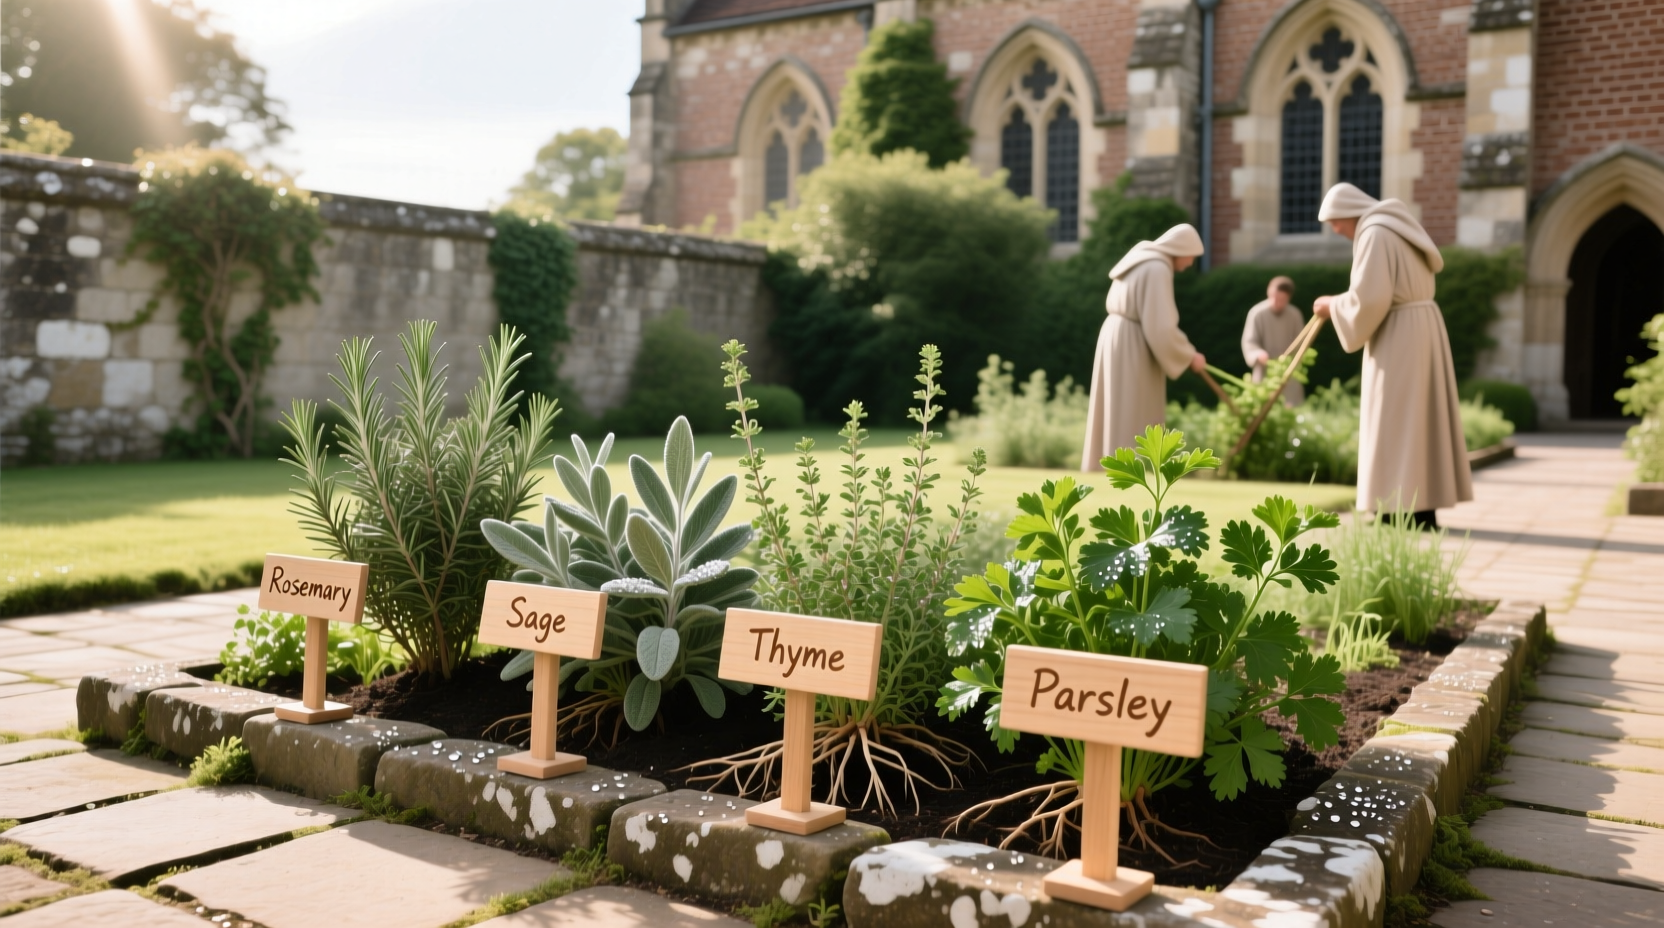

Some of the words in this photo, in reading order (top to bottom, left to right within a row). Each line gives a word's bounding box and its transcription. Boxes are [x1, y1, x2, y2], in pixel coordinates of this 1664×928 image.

[268, 565, 352, 613] Rosemary
[505, 595, 566, 643] Sage
[748, 627, 846, 679] Thyme
[1030, 667, 1173, 738] Parsley
